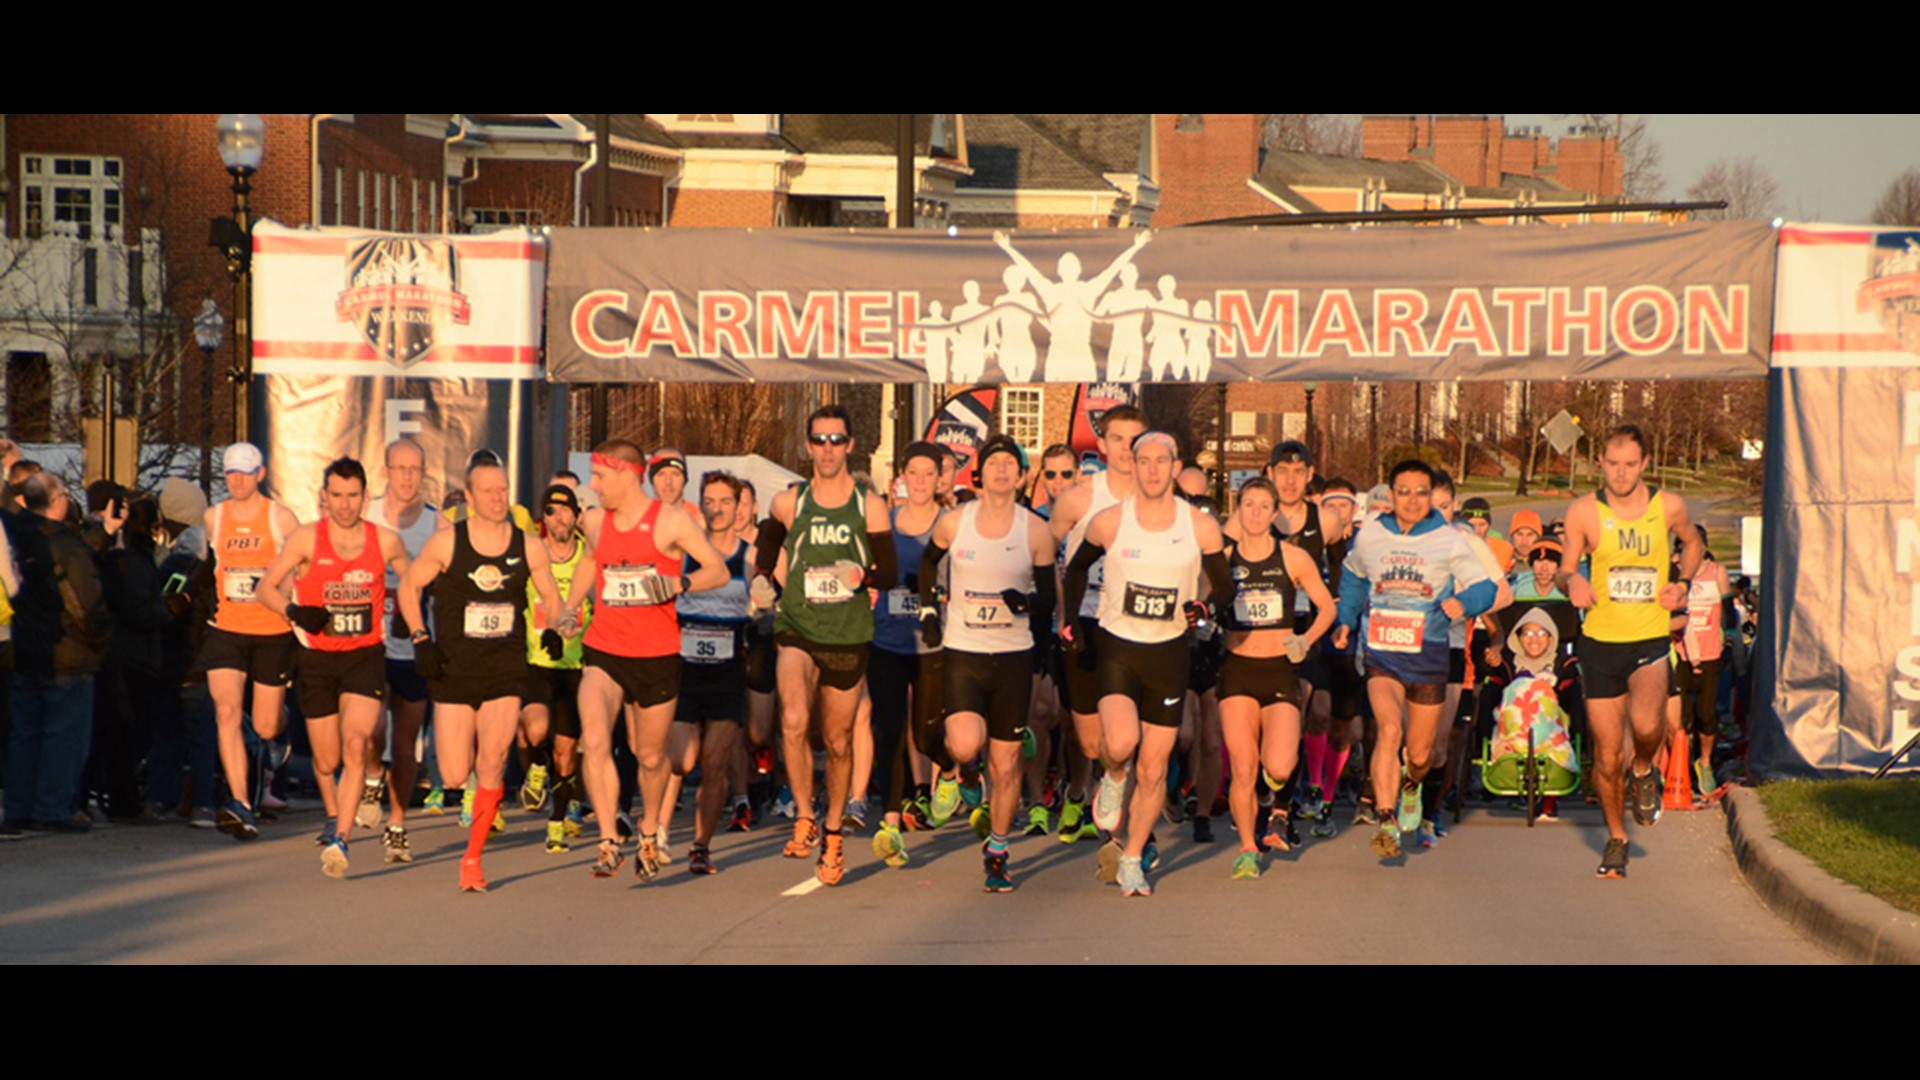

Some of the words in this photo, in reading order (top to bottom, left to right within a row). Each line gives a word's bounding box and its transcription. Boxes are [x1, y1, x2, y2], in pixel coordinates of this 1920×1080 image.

[571, 289, 930, 358] CARMEL
[1215, 285, 1750, 359] MARATHON
[810, 524, 850, 545] NAC
[1618, 527, 1650, 556] MU
[226, 537, 261, 550] PBT
[324, 588, 372, 601] FORUM
[618, 582, 636, 597] 31
[1612, 579, 1654, 596] 4473
[901, 596, 920, 611] 45
[1134, 594, 1166, 616] 513
[1248, 602, 1268, 619] 48
[976, 606, 998, 621] 47
[333, 613, 363, 632] 511
[1376, 626, 1415, 644] 1065
[696, 640, 716, 657] 35
